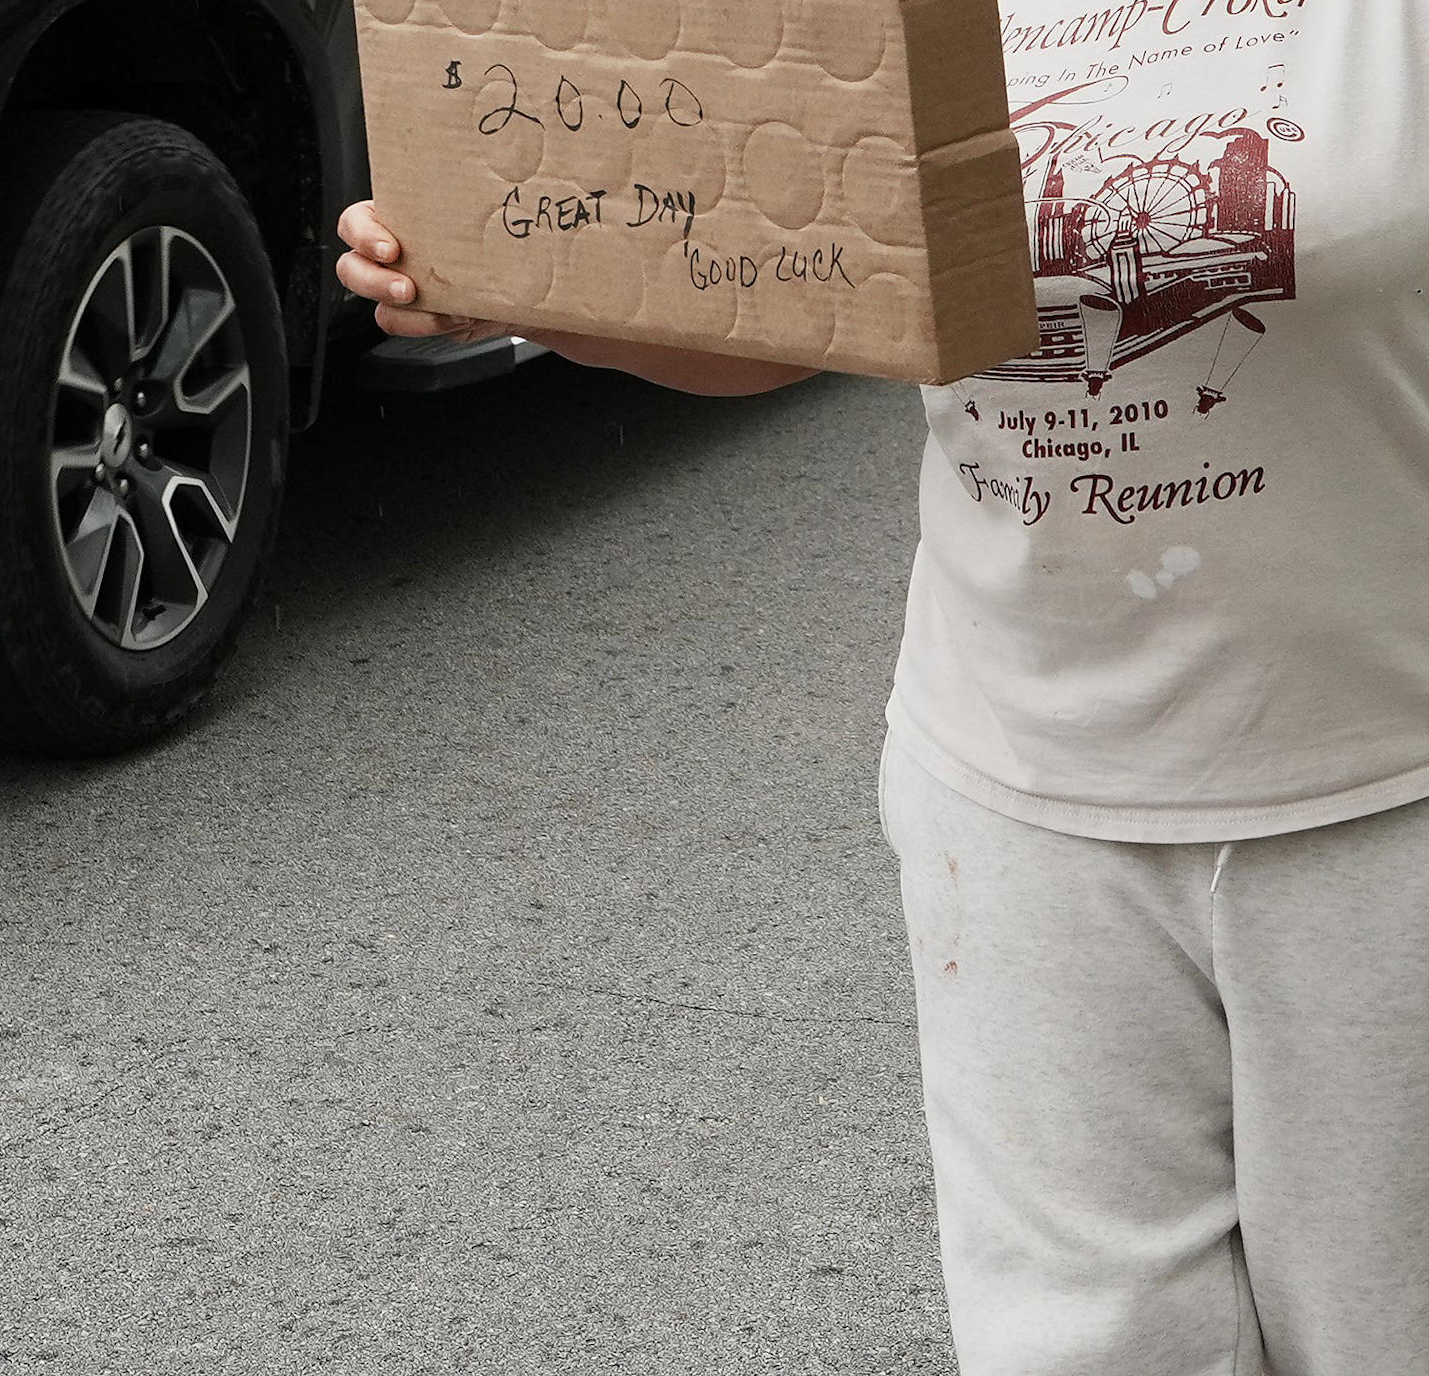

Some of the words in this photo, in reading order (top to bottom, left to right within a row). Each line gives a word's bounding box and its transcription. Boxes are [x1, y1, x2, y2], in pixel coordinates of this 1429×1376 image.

[1006, 72, 1051, 88] ping
[1058, 68, 1076, 83] In
[1086, 61, 1120, 80] The
[1128, 46, 1193, 71] Name
[1203, 35, 1230, 53] of
[502, 185, 607, 239] GREAT
[626, 183, 696, 257] DAY
[690, 248, 758, 291] GOOD
[776, 243, 856, 289] LUCK
[998, 409, 1036, 436] July
[1044, 409, 1099, 432] 9-11,
[1110, 399, 1169, 426] 2010
[1022, 437, 1111, 461] Chicago,
[1121, 432, 1140, 452] IL
[959, 461, 1051, 526] Family
[1070, 462, 1266, 525] Reunion
